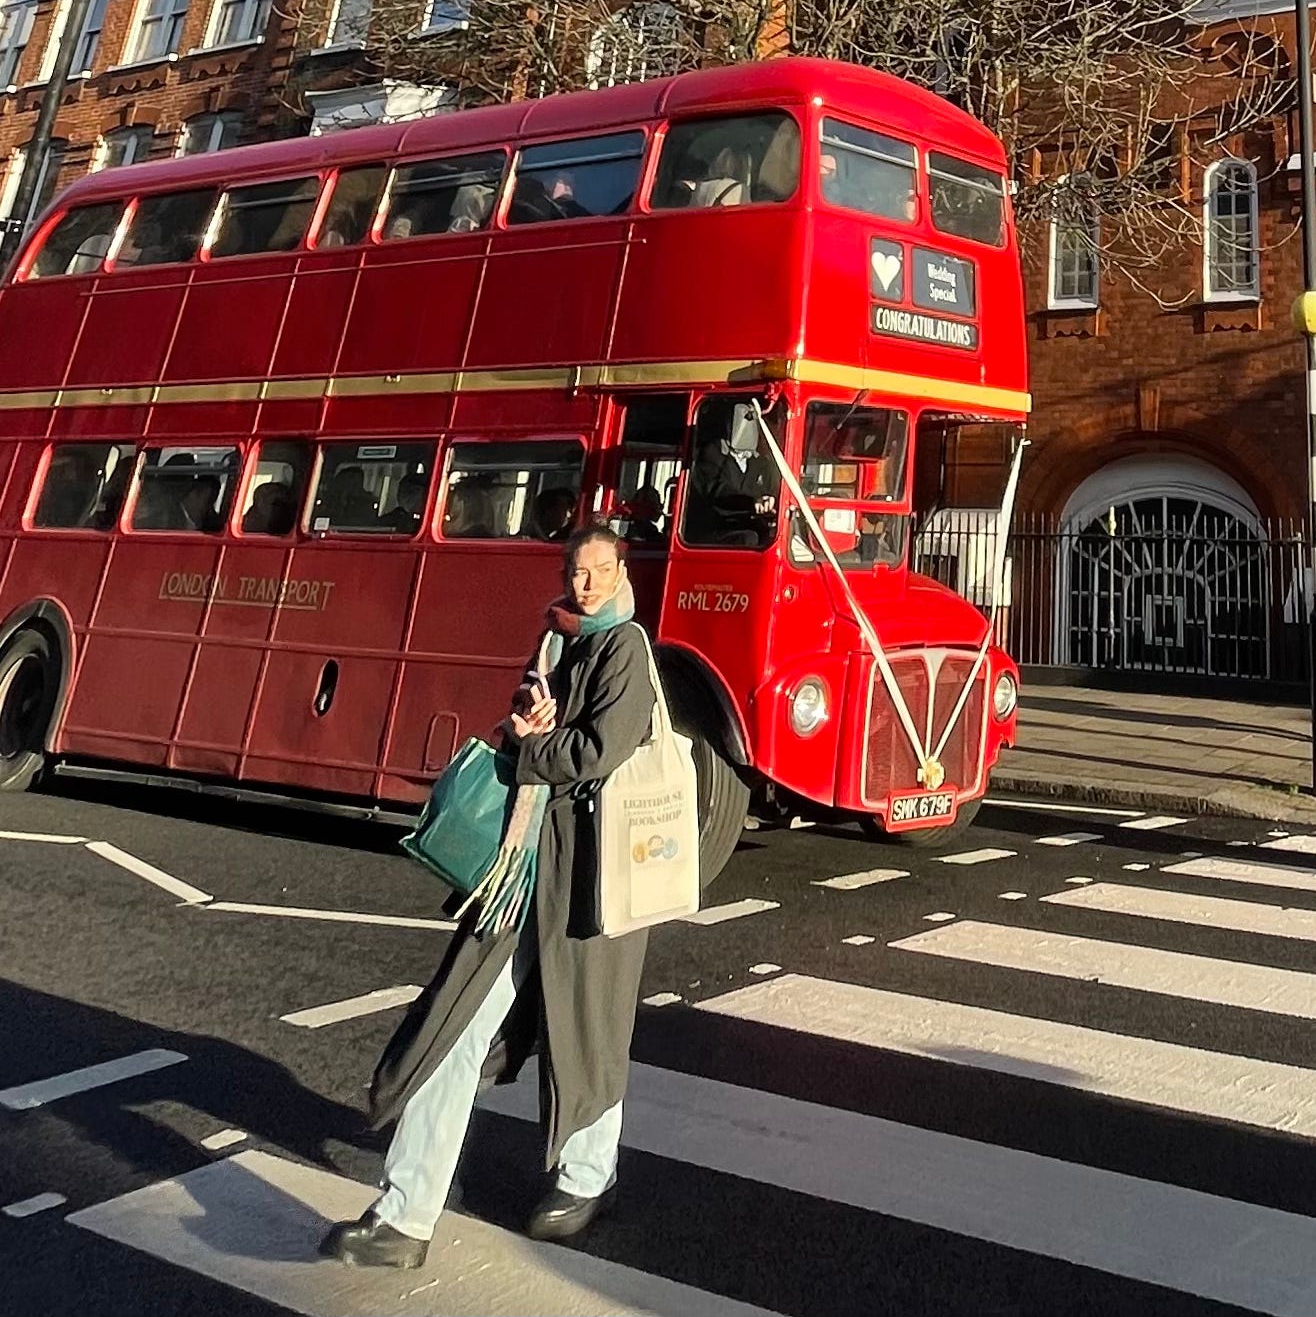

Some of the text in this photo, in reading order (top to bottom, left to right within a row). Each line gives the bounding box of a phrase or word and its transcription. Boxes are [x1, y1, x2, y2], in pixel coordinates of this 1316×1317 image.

[927, 263, 957, 288] Wedding
[929, 282, 957, 303] Special
[875, 308, 971, 345] CONGRATULATIONS
[237, 576, 336, 611] TRANPORT
[677, 591, 750, 613] RML 2679
[628, 808, 683, 827] BOOKSHOP
[893, 795, 952, 821] SMK 679F
